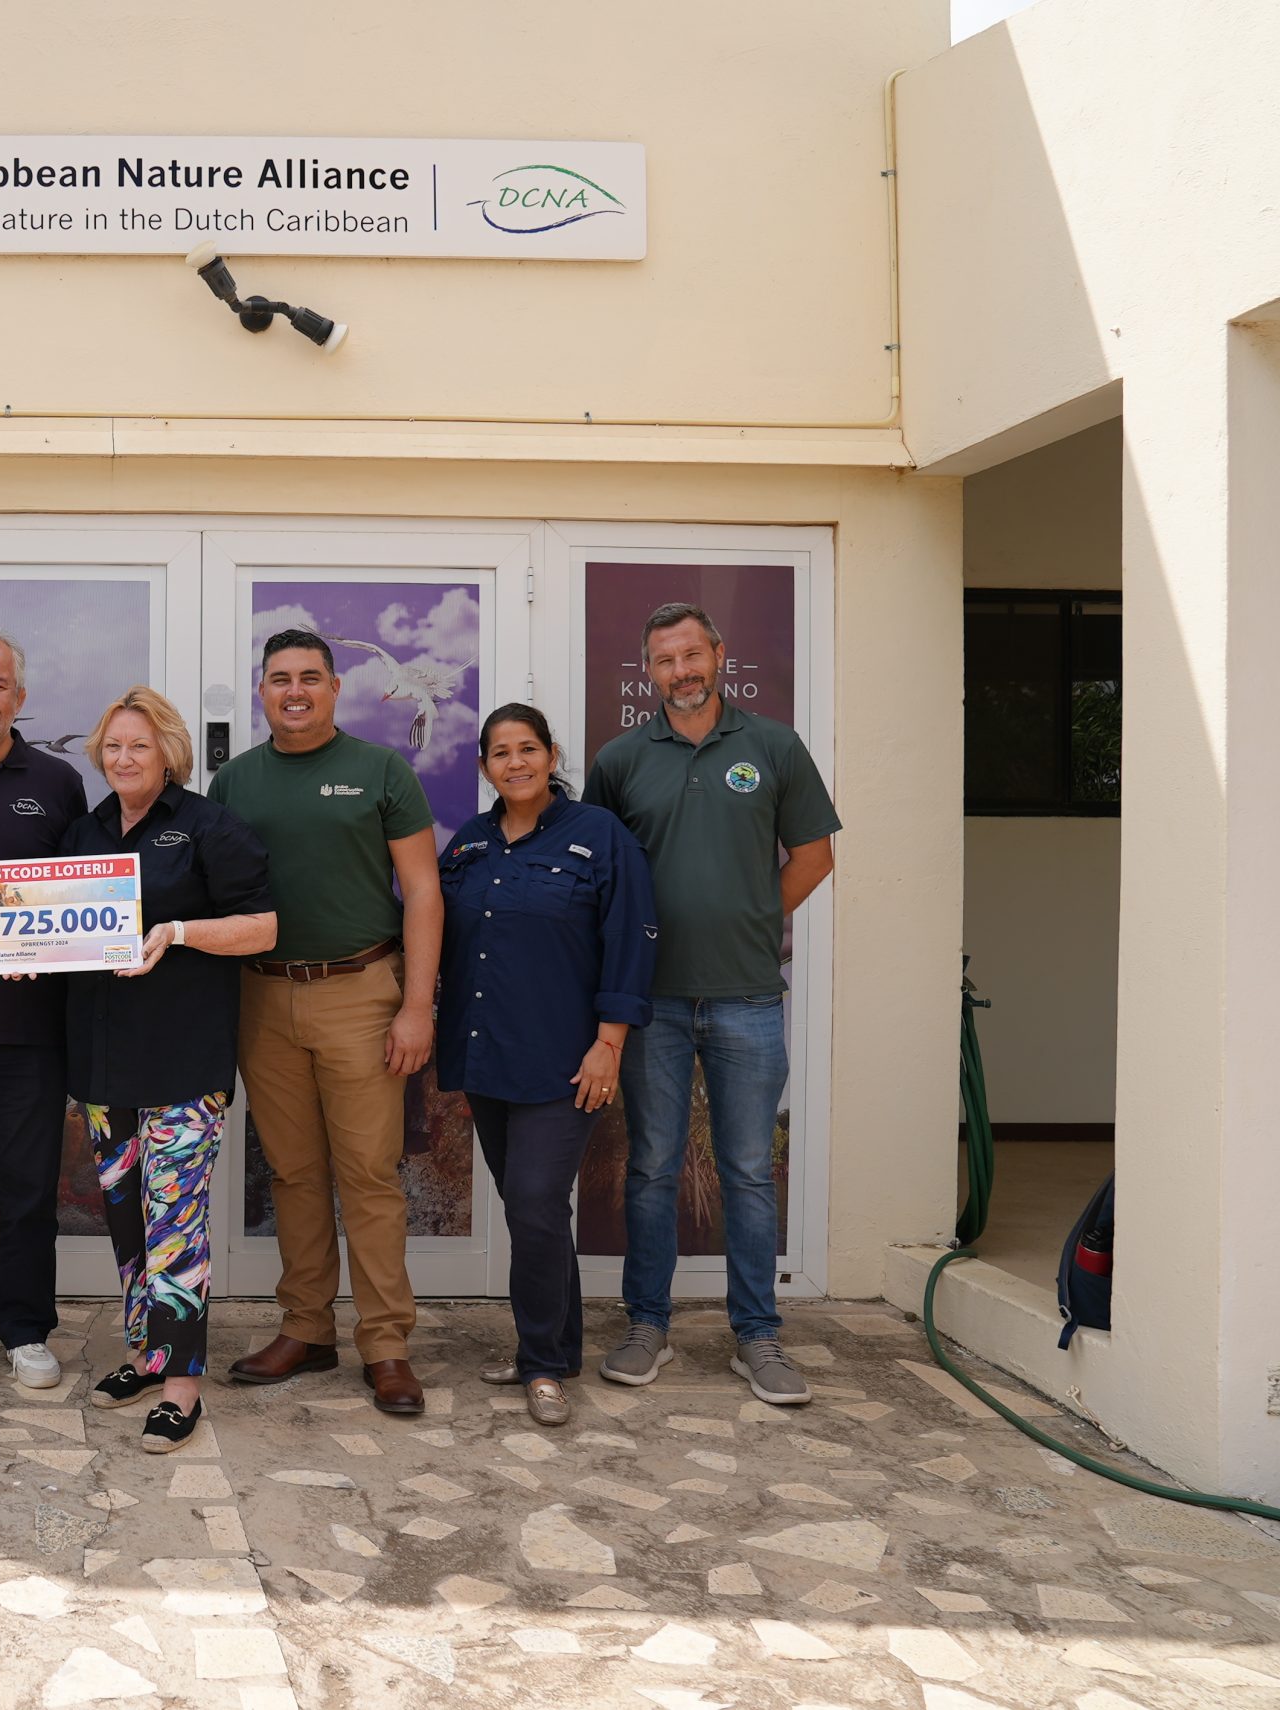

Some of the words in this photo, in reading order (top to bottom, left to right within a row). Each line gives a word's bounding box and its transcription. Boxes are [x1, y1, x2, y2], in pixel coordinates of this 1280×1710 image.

[118, 158, 243, 188] Nature
[257, 158, 410, 190] Alliance
[498, 186, 589, 209] DCNA
[85, 208, 107, 231] in
[120, 208, 163, 231] the
[174, 208, 255, 231] Dutch
[267, 208, 409, 233] Caribbean
[724, 683, 758, 699] NO
[17, 801, 40, 812] DCNA
[159, 834, 184, 842] DCNA
[55, 862, 114, 877] LOTERIJ
